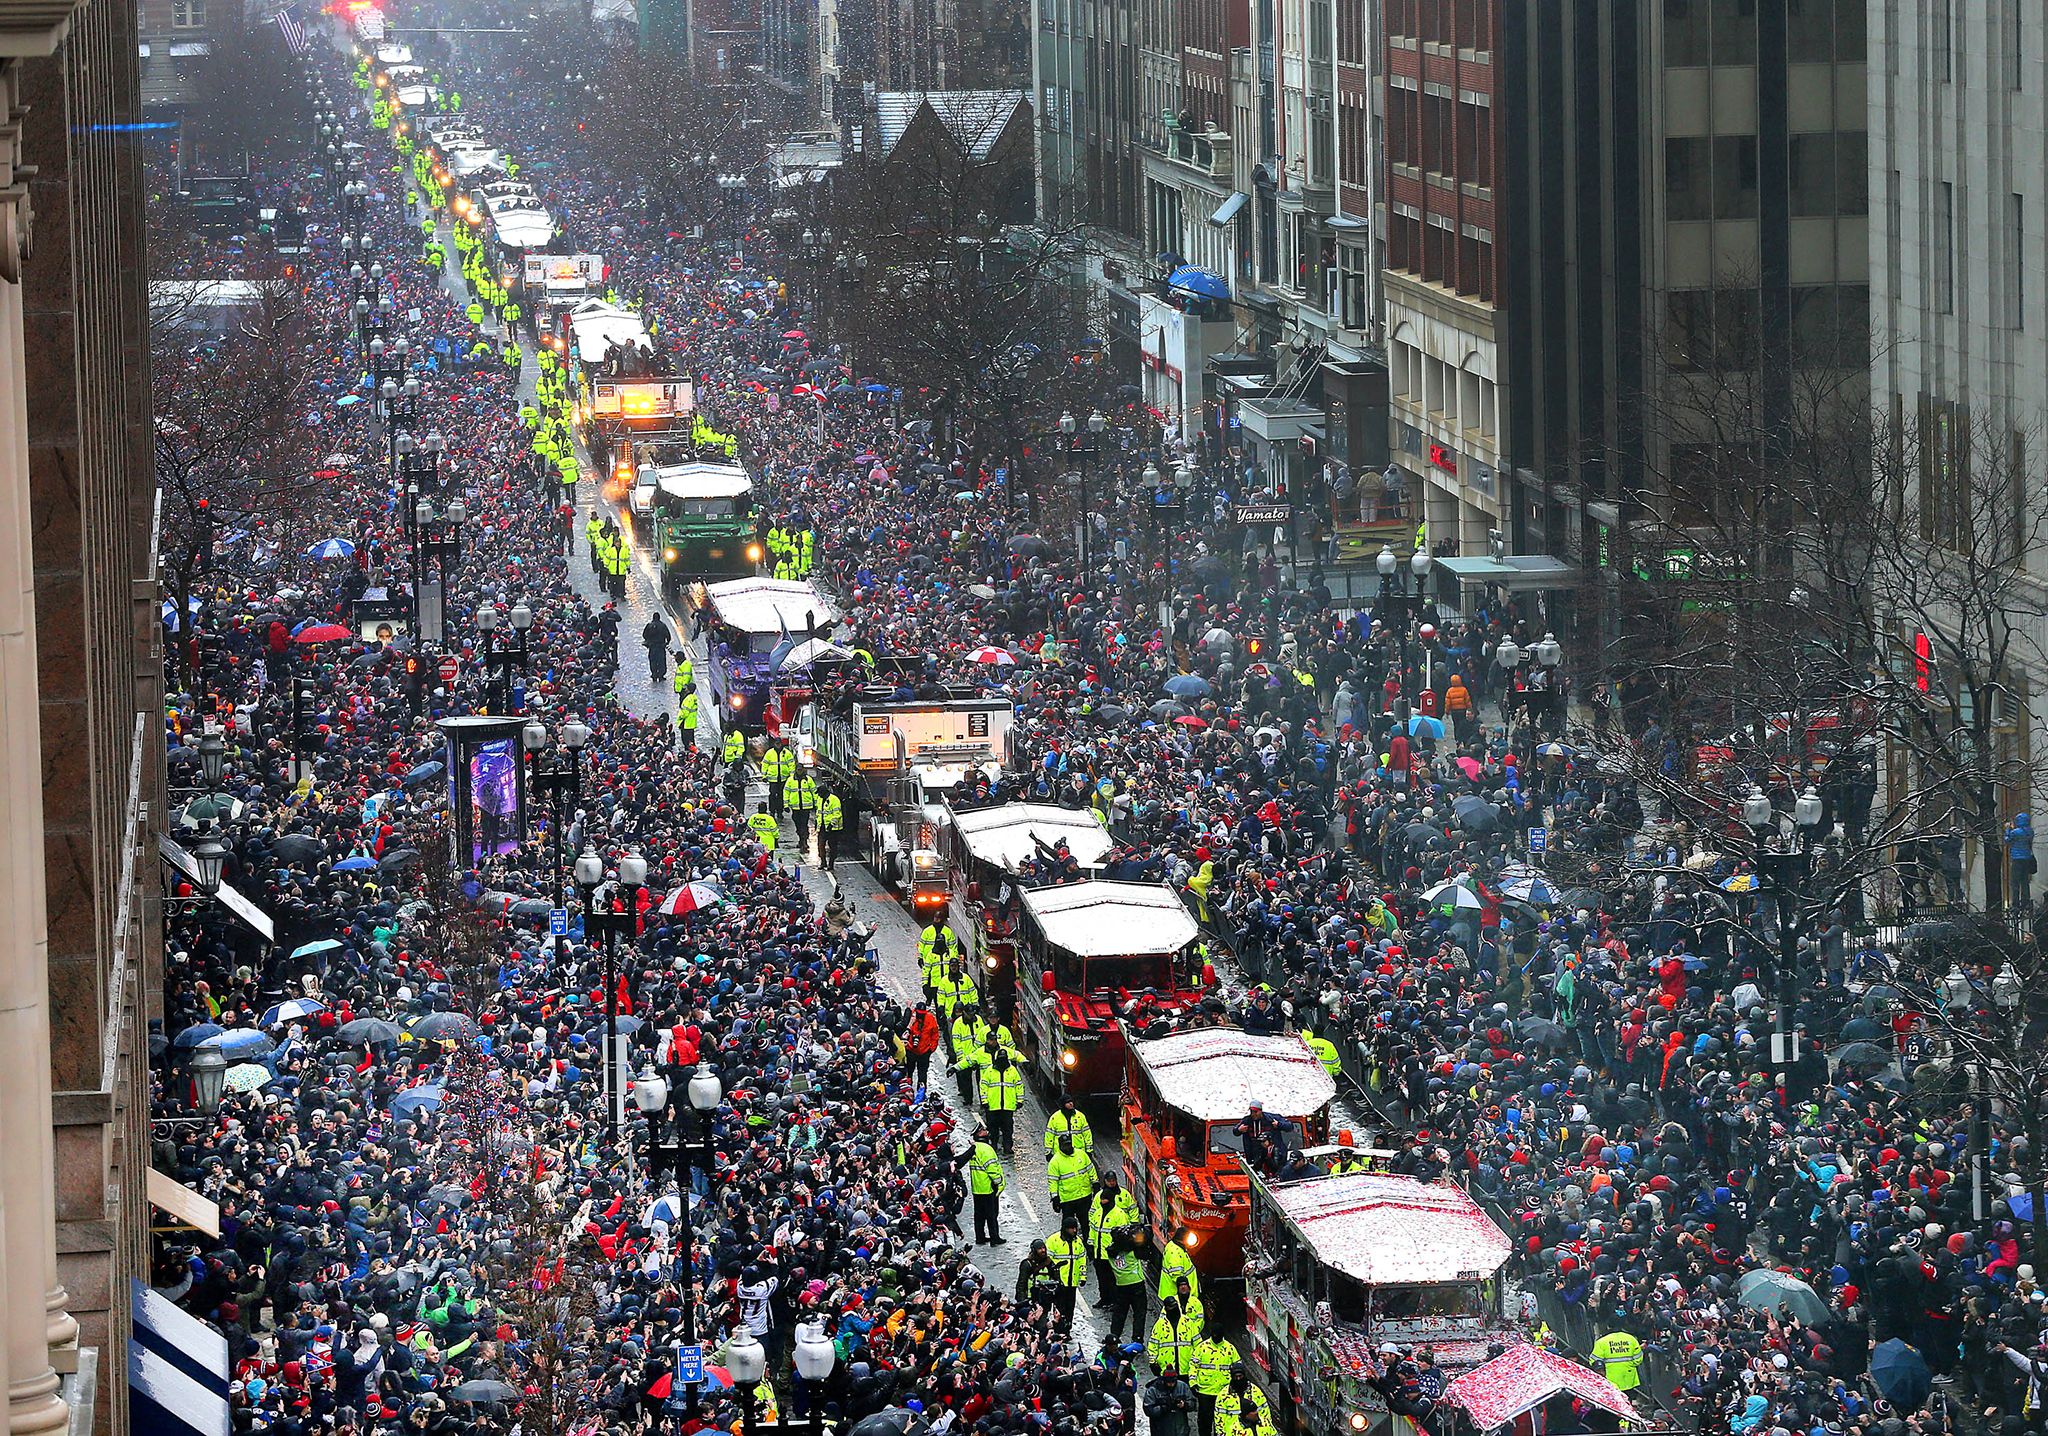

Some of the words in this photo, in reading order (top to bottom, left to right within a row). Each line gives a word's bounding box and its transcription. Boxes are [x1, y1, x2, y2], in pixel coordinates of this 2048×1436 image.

[1237, 507, 1284, 524] Yamato
[563, 975, 578, 989] 12
[1610, 1346, 1630, 1354] Police
